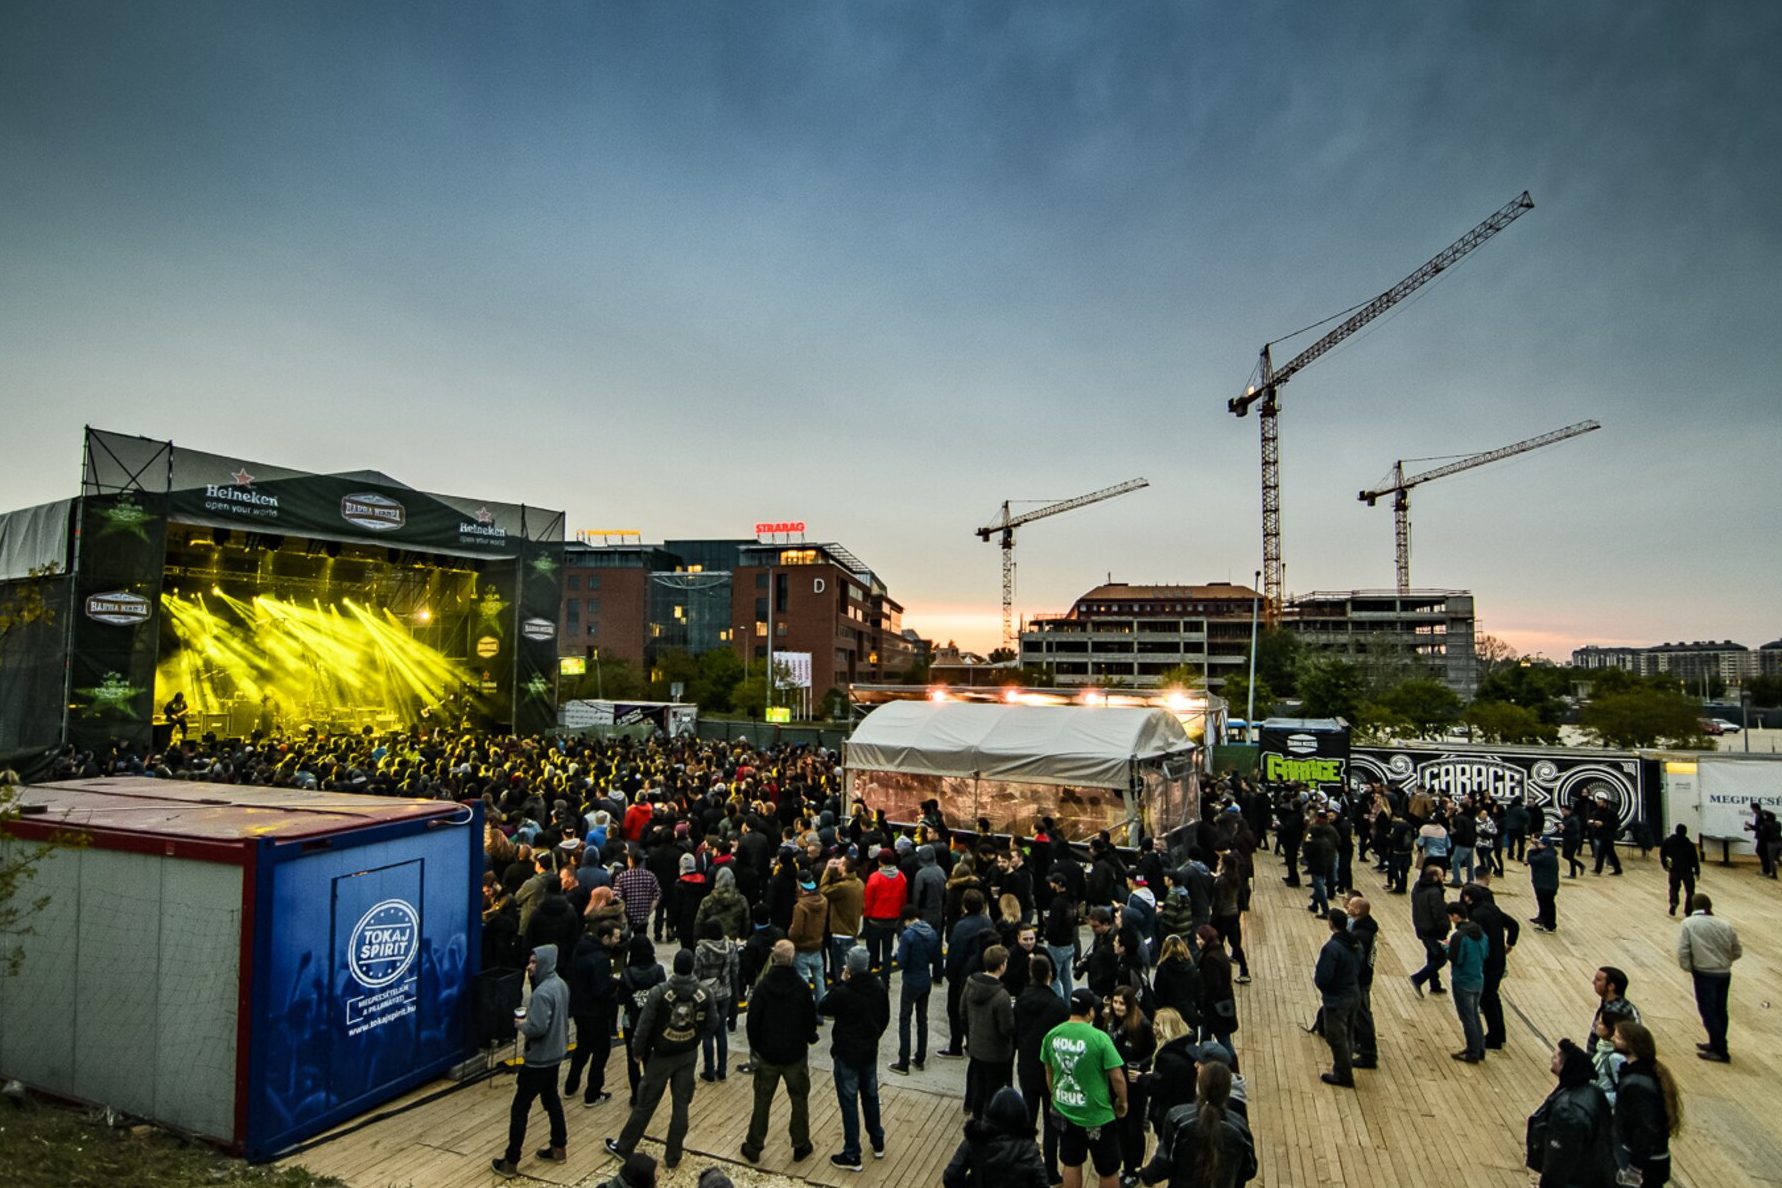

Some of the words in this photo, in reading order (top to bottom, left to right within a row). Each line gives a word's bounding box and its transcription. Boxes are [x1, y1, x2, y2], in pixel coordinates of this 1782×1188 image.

[206, 484, 279, 507] Heineken
[205, 501, 229, 510] open
[232, 505, 251, 514] your
[253, 508, 278, 517] world
[460, 522, 505, 537] Heineken
[755, 522, 805, 533] STRABAG
[813, 578, 825, 593] D
[1267, 755, 1341, 781] GARAGE
[1424, 763, 1522, 798] GARAGE
[364, 928, 410, 945] TOKAJ
[360, 942, 408, 959] SPIRIT
[1052, 1037, 1086, 1052] HOLD
